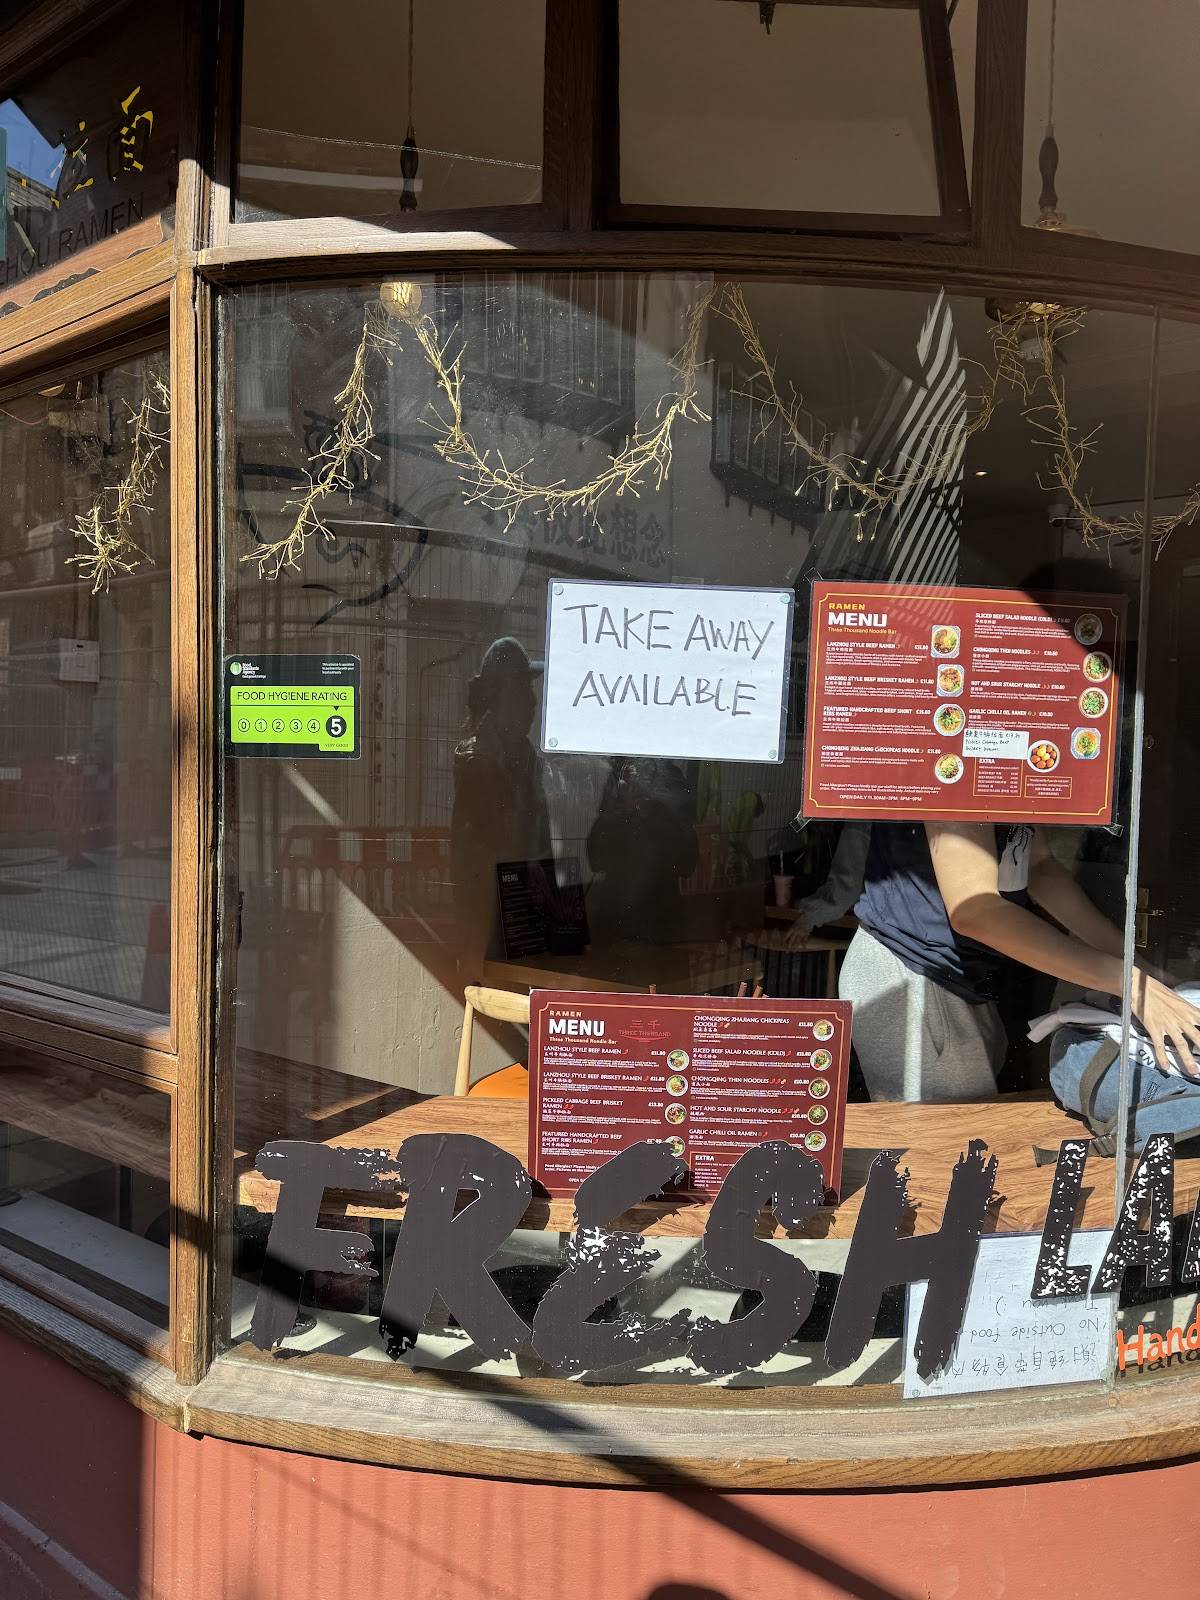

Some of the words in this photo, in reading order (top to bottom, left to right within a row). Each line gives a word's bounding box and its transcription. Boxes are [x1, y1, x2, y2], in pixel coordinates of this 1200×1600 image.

[59, 191, 144, 255] RAMEN
[828, 612, 887, 627] MENU
[563, 604, 674, 651] TAKE
[684, 614, 775, 660] AWAY
[237, 692, 266, 701] FOOD
[268, 692, 309, 701] HYGIENE
[311, 692, 347, 701] RATING
[573, 671, 757, 716] AVAILABLE
[331, 718, 341, 735] 5
[549, 1018, 605, 1037] MENU
[250, 1133, 1000, 1382] FRESH
[1010, 1322, 1066, 1340] Outside
[1079, 1318, 1099, 1332] No
